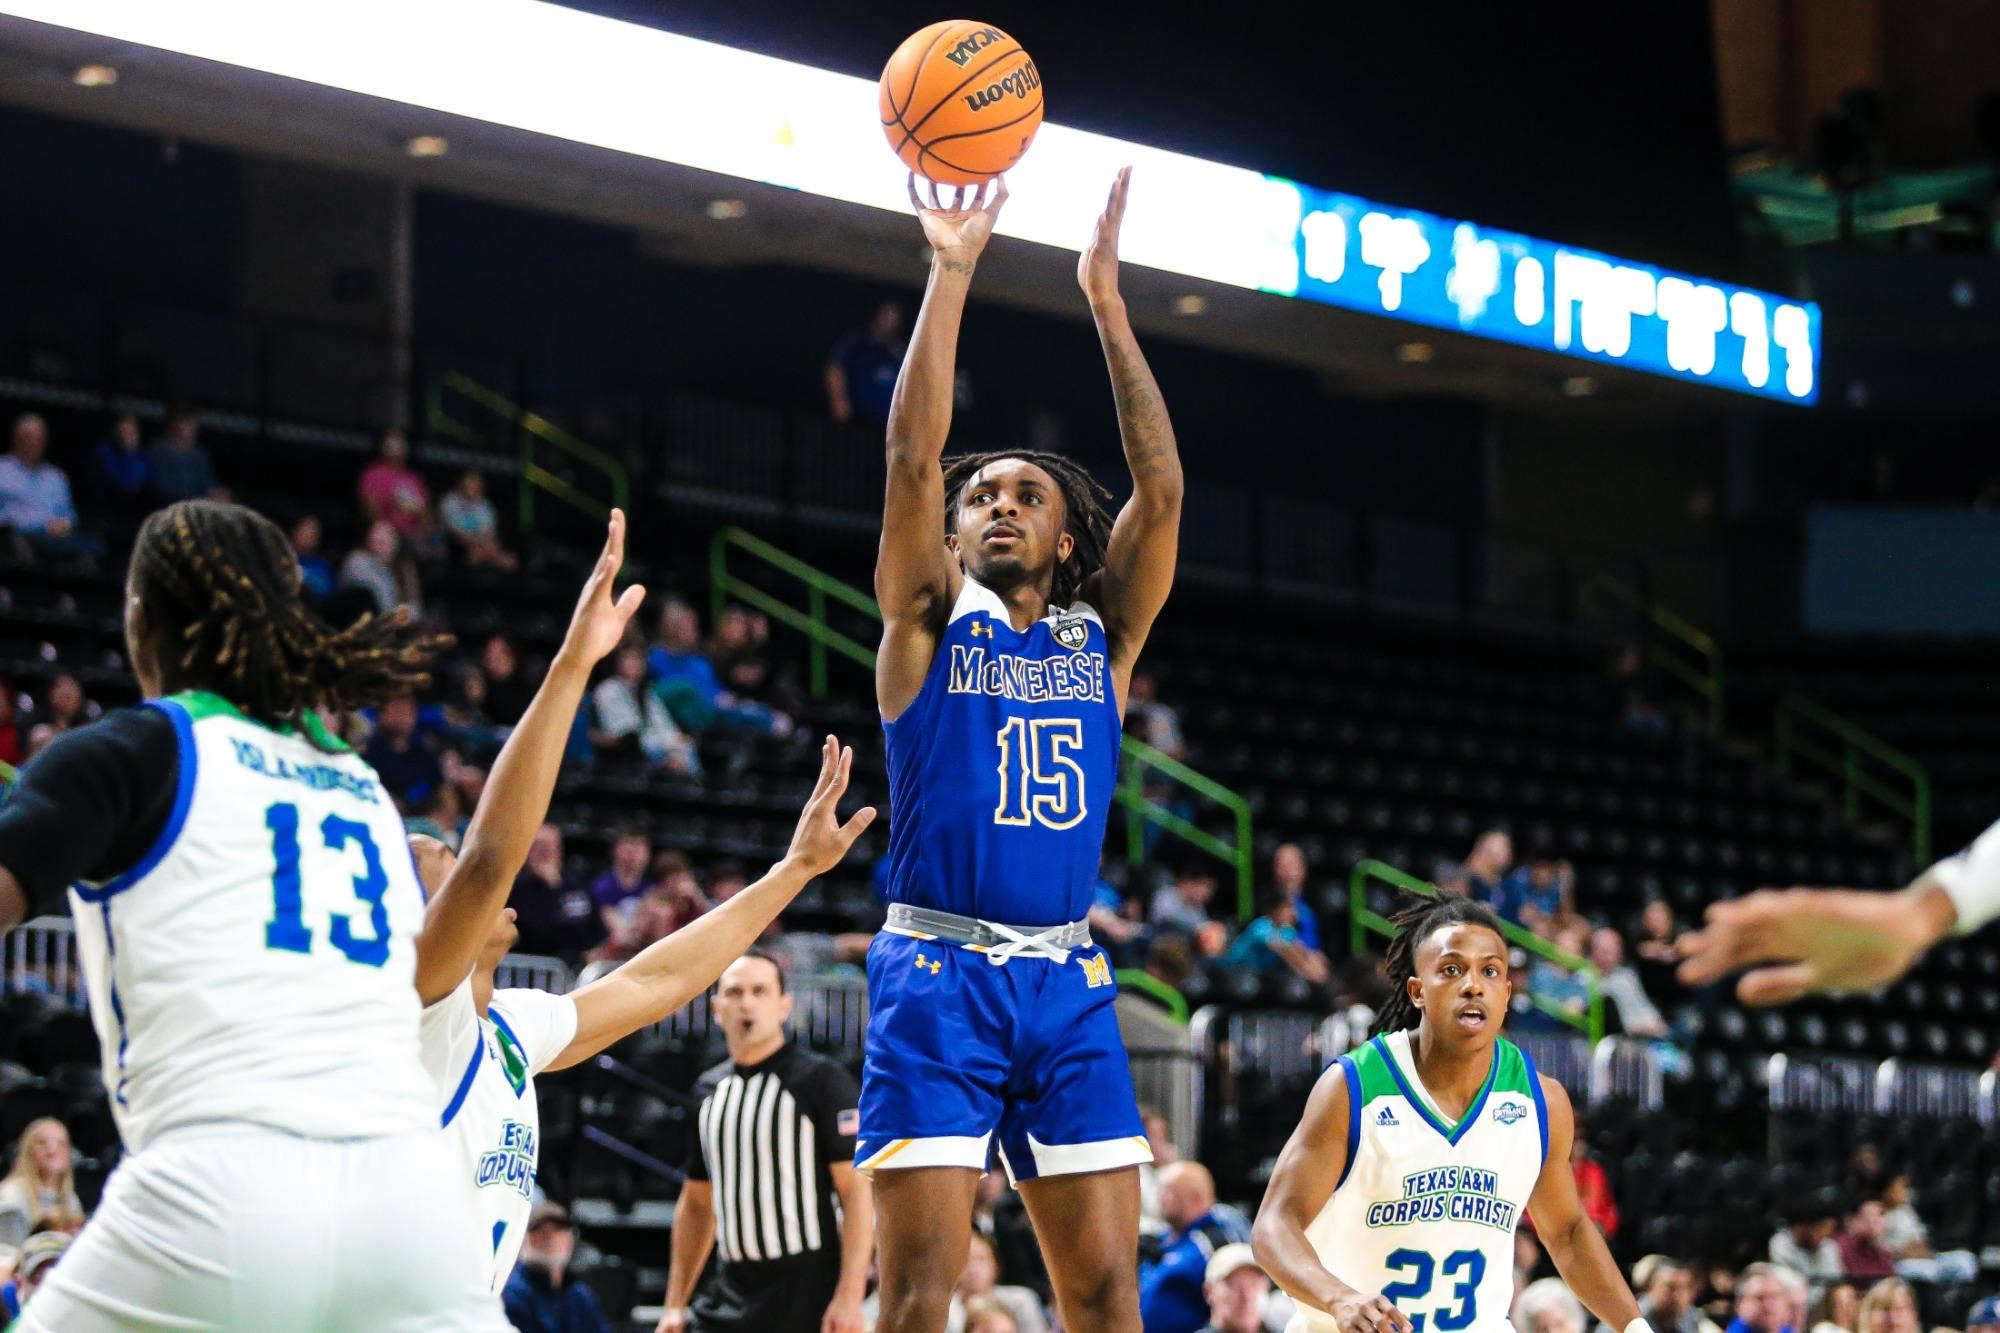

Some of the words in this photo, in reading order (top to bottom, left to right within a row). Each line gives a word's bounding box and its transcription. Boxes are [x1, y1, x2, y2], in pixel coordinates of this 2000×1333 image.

[946, 28, 1006, 67] NCAA
[964, 59, 1041, 112] Wilson
[1060, 626, 1084, 643] 60
[994, 716, 1088, 831] 15
[265, 801, 391, 968] 13
[1078, 951, 1113, 989] M
[1404, 1167, 1458, 1198] TEXAS
[1461, 1169, 1497, 1196] A&M
[1367, 1195, 1446, 1226] CORPUS
[1449, 1195, 1515, 1231] CHRISTI
[1381, 1248, 1487, 1333] 23
